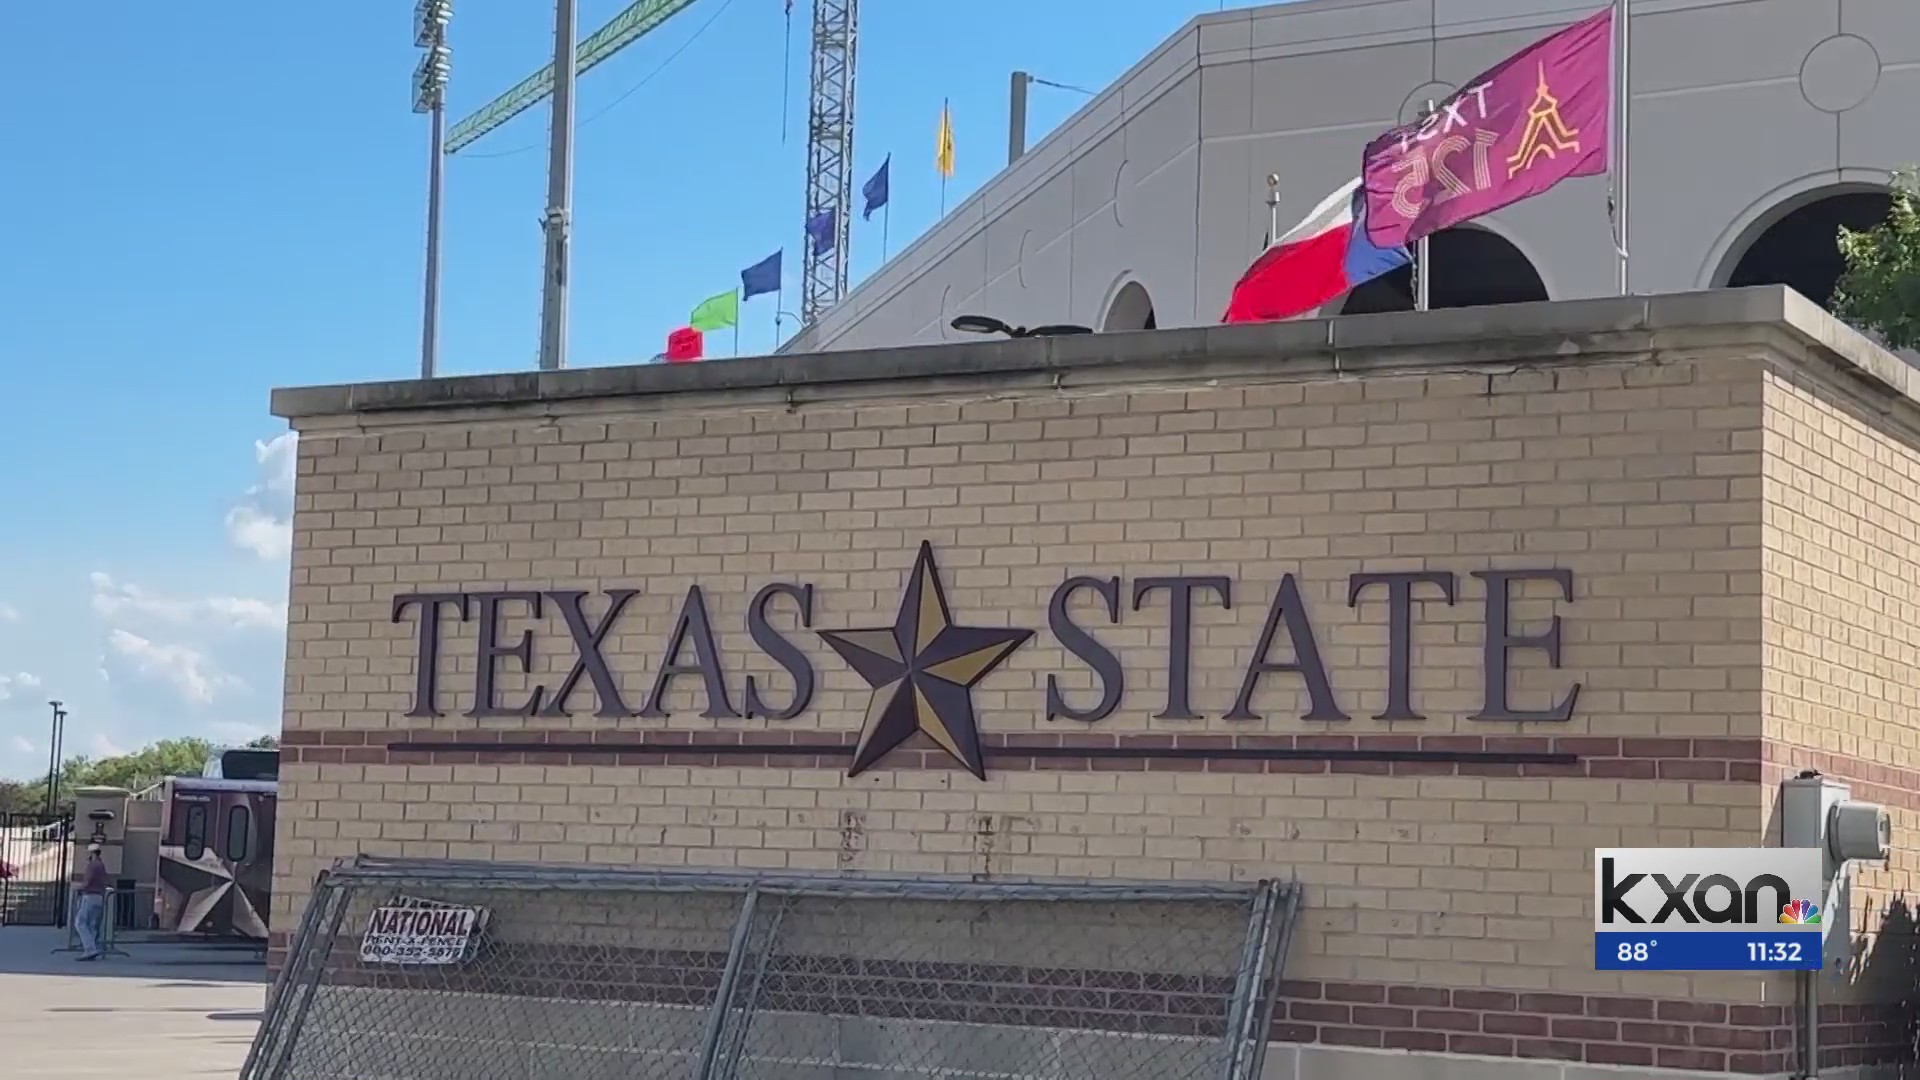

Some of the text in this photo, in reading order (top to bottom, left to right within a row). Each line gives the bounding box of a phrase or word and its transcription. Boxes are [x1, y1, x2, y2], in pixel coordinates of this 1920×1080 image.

[392, 569, 1581, 721] TEXAS STATE
[369, 909, 468, 936] NATIONAL
